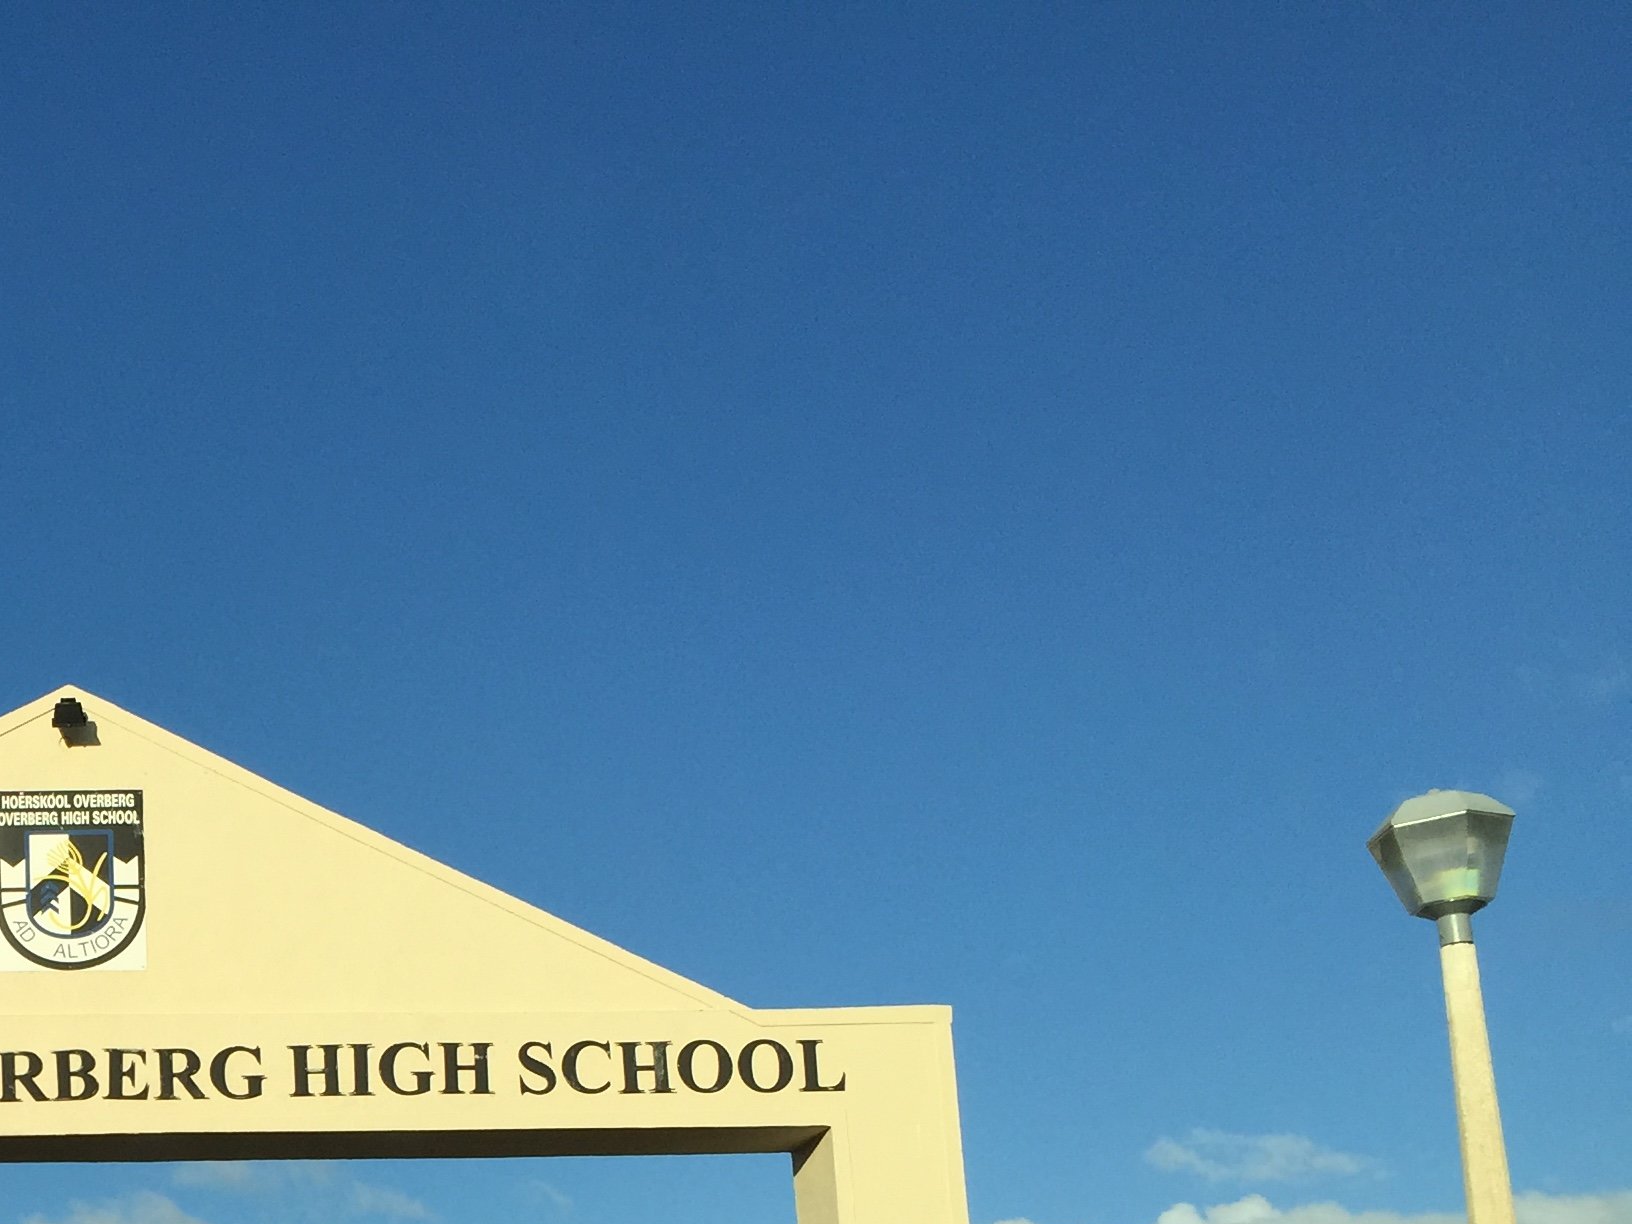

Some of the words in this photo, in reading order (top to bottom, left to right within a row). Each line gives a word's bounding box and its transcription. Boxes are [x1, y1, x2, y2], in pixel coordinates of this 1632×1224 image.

[1, 790, 71, 810] HOËRSKOOL
[72, 793, 135, 809] OVERBERG
[61, 809, 90, 826] HIGH
[91, 808, 140, 826] SCHOOL
[13, 918, 36, 943] AD
[53, 916, 129, 959] ALTIORA
[287, 1042, 495, 1097] HIGH
[519, 1039, 845, 1095] SCHOOL
